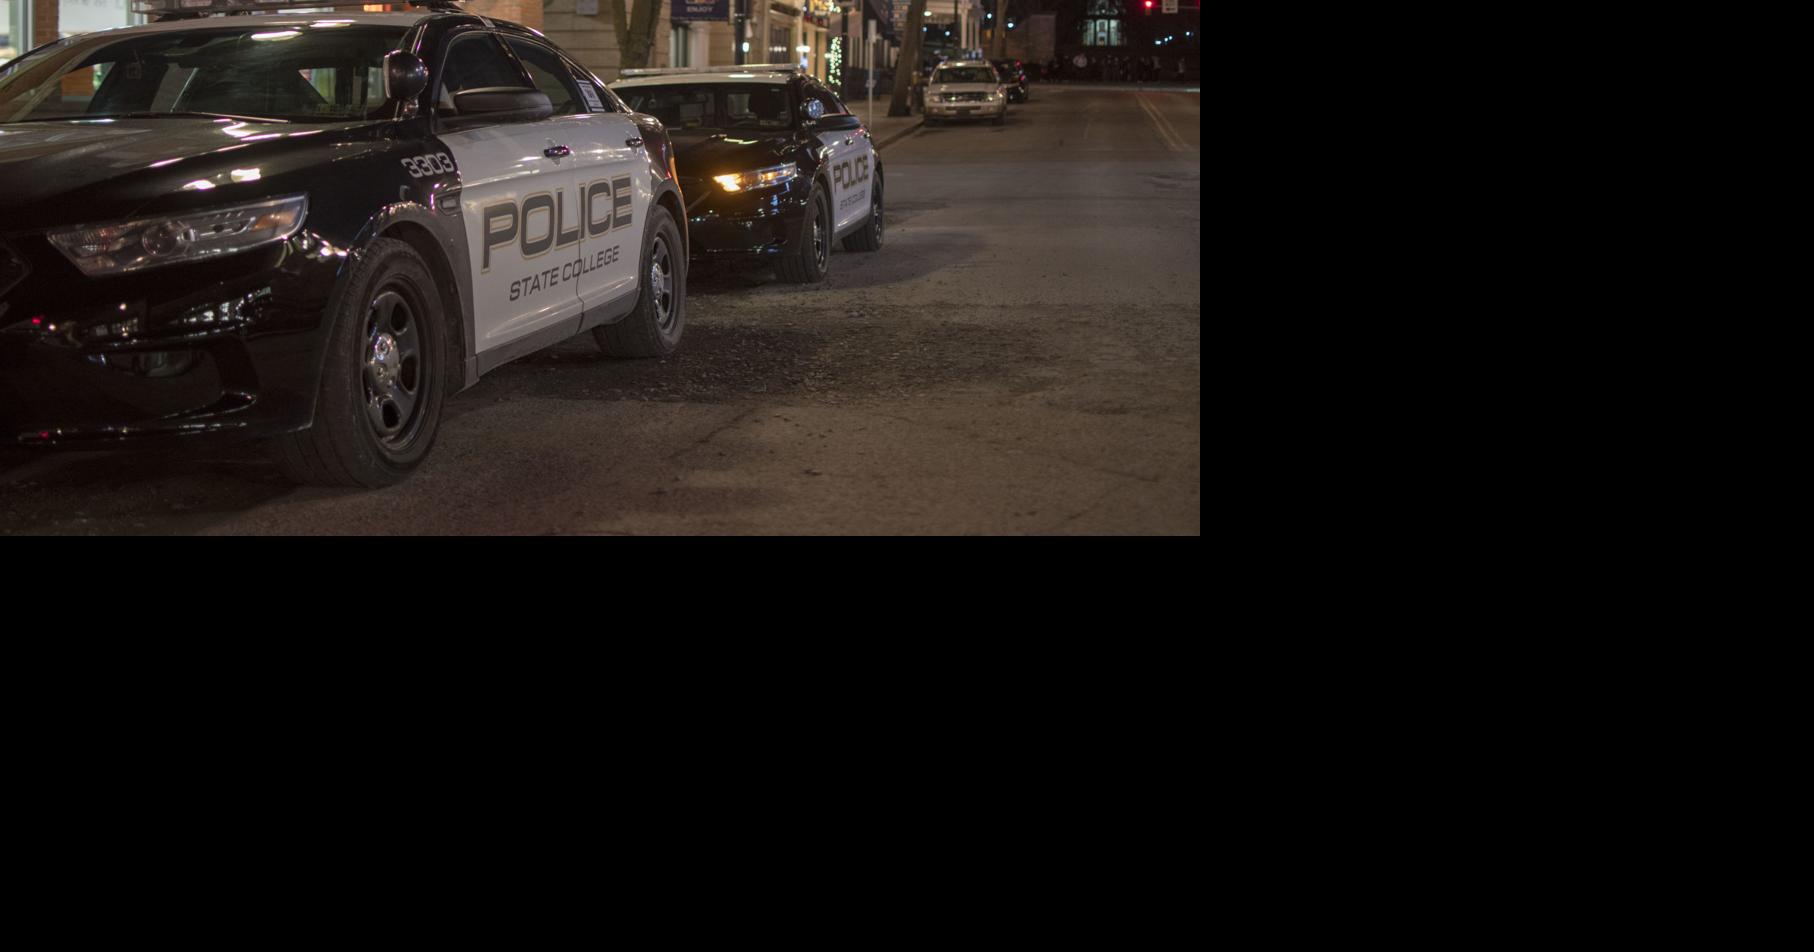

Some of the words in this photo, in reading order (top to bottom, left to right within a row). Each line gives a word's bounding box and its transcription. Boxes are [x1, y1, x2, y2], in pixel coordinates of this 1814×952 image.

[400, 152, 455, 178] 3303
[832, 154, 869, 194] POLICE
[481, 173, 633, 275] POLICE
[509, 266, 560, 302] STATE
[562, 245, 620, 282] COLLEGE
